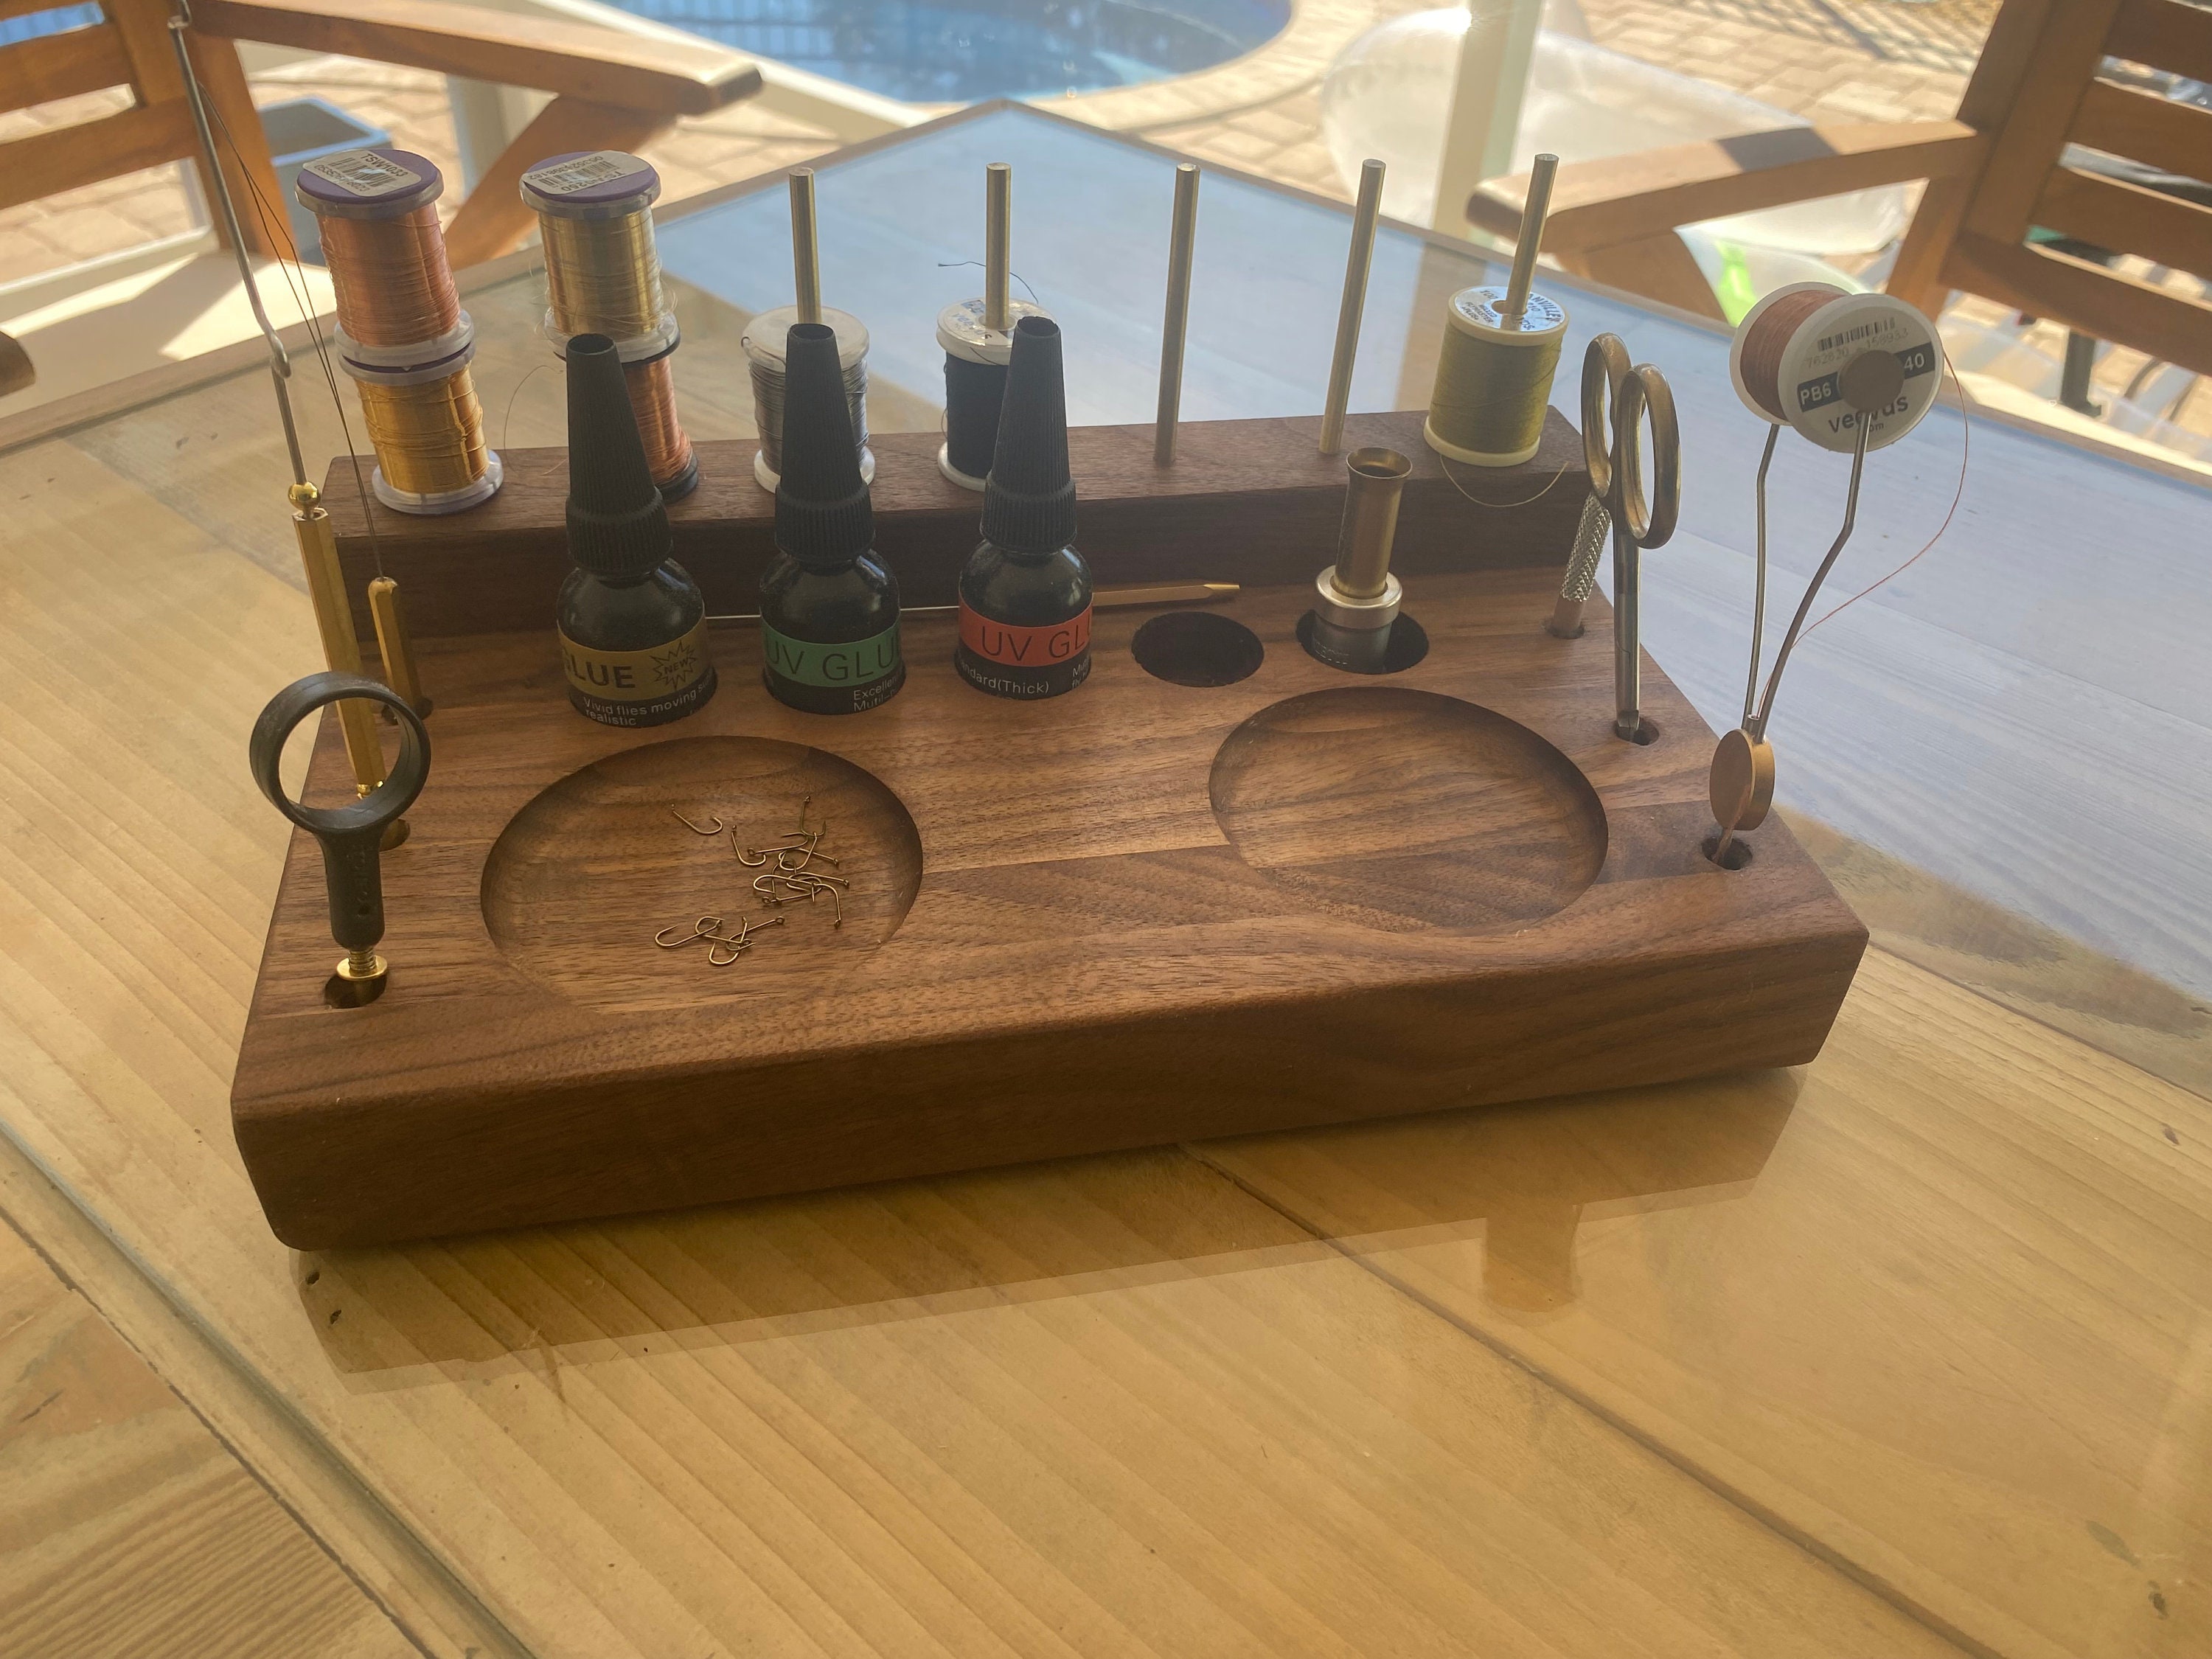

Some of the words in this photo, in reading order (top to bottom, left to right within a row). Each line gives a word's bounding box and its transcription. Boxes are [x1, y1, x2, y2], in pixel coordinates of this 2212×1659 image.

[361, 153, 408, 177] TSW1033
[1800, 382, 1832, 405] PB6
[1904, 352, 1925, 371] 40
[982, 625, 1032, 661] UV
[664, 655, 689, 675] NEW
[765, 633, 805, 675] UV
[821, 636, 895, 681] GLU
[583, 696, 613, 714] Vivid
[616, 706, 647, 716] flies
[651, 689, 697, 714] moving
[585, 709, 636, 726] realistic
